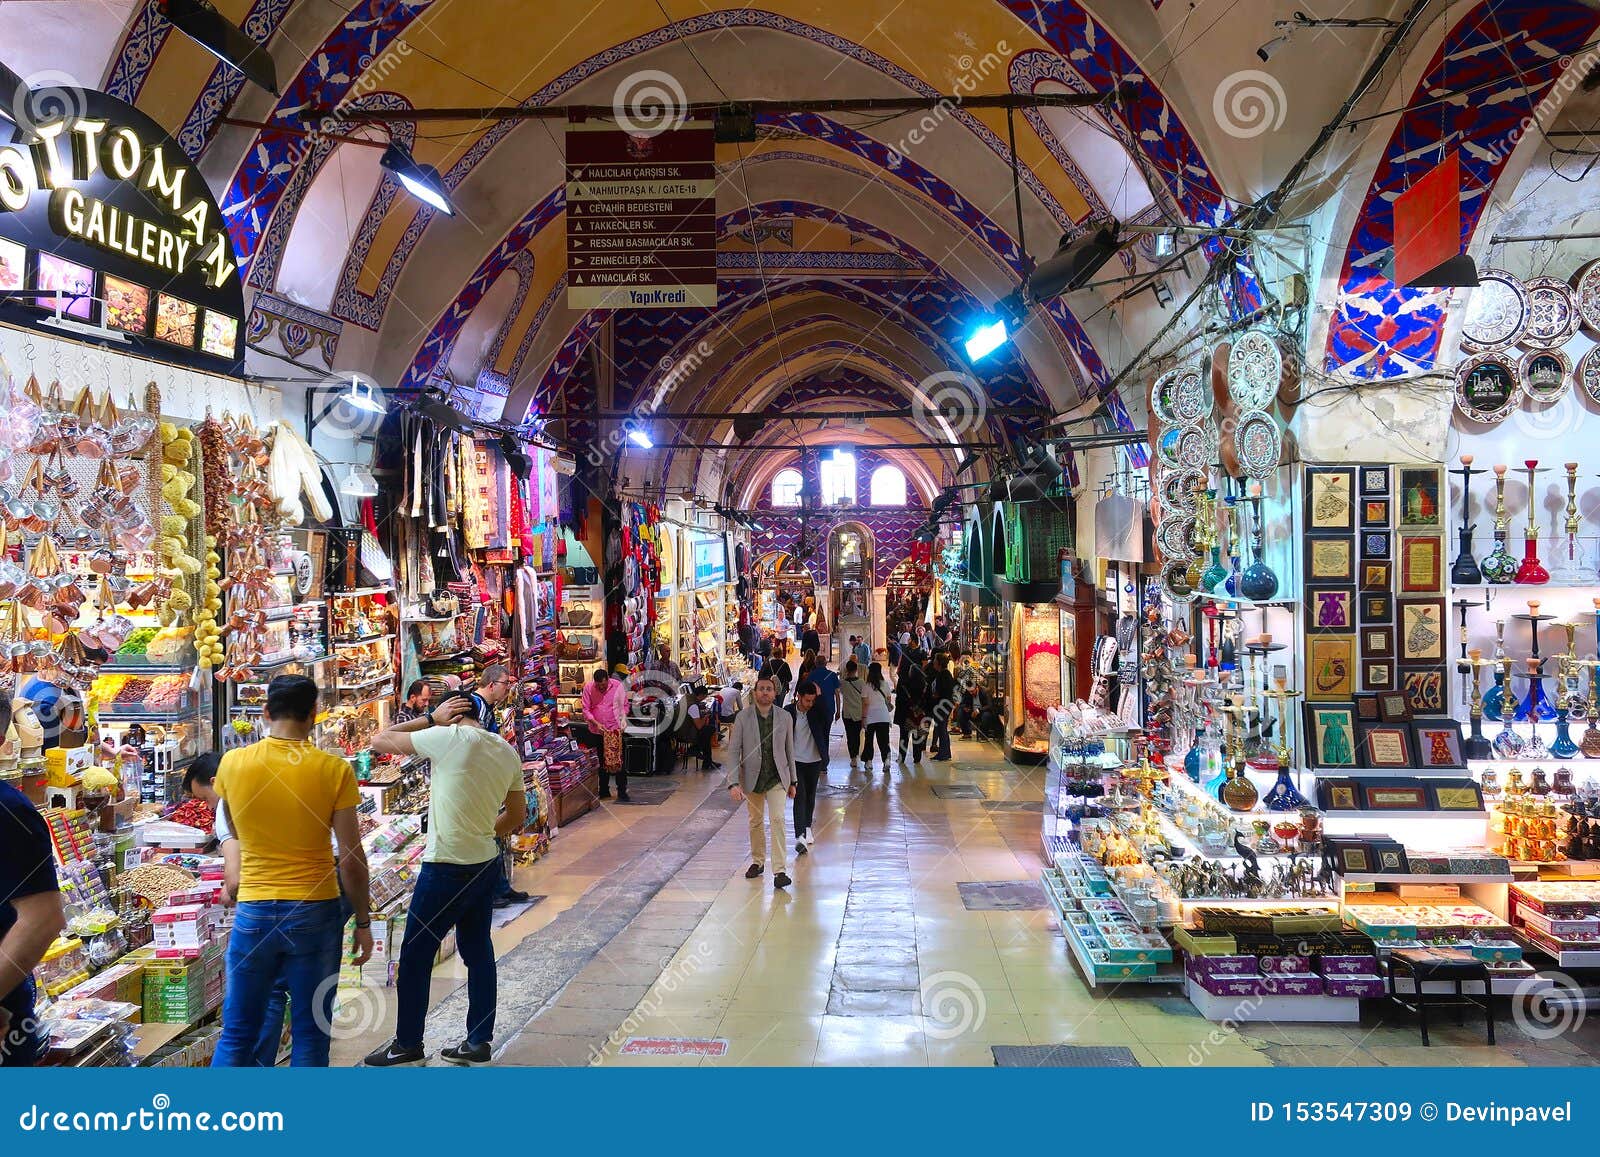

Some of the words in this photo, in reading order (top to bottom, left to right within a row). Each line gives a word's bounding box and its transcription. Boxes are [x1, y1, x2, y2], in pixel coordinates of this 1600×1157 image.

[588, 168, 632, 178] HALICILAR
[633, 167, 666, 179] ÇARŞISI
[667, 167, 682, 177] SK.
[589, 186, 646, 196] MAHMUTPAŞA
[0, 119, 235, 288] OTTOMAN
[589, 203, 626, 213] CEVAHİR
[627, 201, 673, 212] BEDESTENİ
[642, 220, 656, 229] SK.
[63, 190, 191, 273] GALLERY
[590, 238, 624, 248] RESSAM
[626, 238, 679, 247] BASMACILAR
[681, 237, 695, 246] SK.
[590, 254, 641, 265] ZENNECİLER
[642, 255, 656, 265] SK.
[590, 274, 637, 283] AYNACILAR
[639, 273, 653, 282] SK.
[629, 290, 686, 305] YapıKredi
